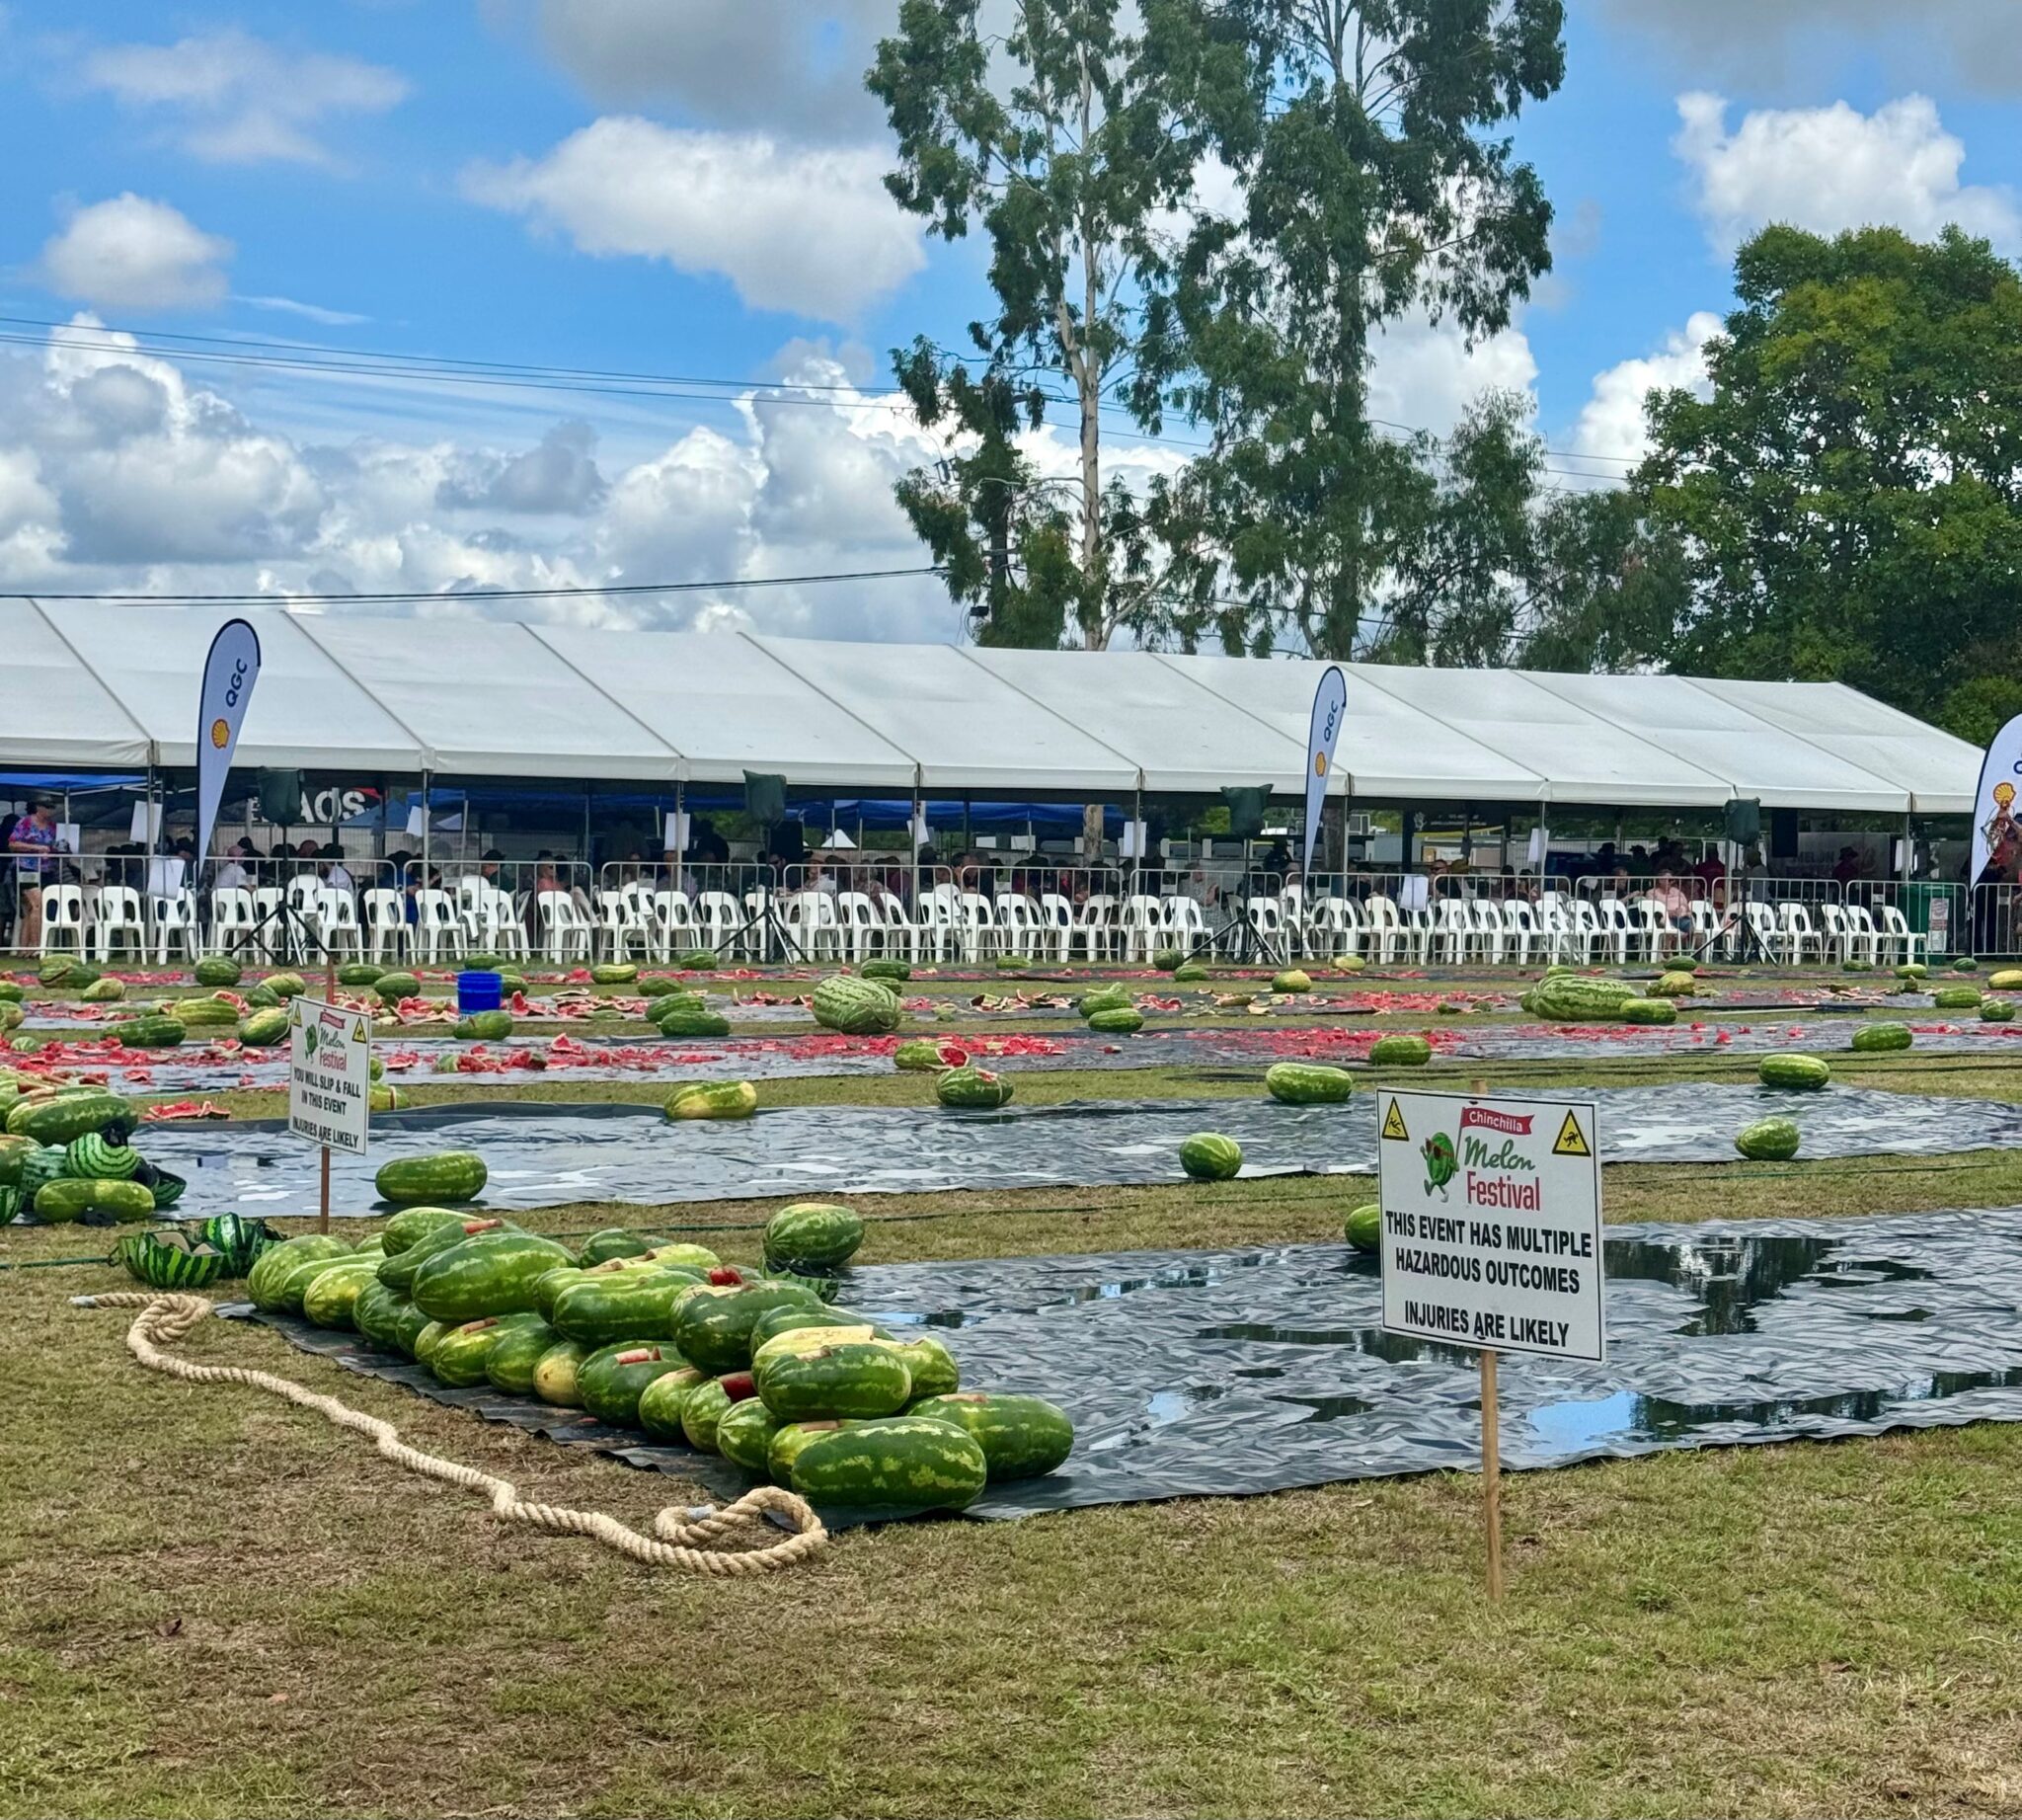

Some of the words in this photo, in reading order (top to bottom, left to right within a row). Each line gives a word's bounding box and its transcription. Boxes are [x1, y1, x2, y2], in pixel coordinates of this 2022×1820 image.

[226, 658, 247, 708] QGC
[1324, 700, 1339, 743] QGC
[319, 1027, 346, 1050] Melon
[320, 1047, 347, 1071] Festival
[294, 1067, 304, 1083] YOU
[305, 1070, 318, 1088] WILL
[320, 1074, 334, 1091] SLIP
[336, 1079, 341, 1094] &
[343, 1081, 361, 1099] FALL
[301, 1089, 308, 1105] IN
[309, 1092, 322, 1109] THIS
[324, 1096, 347, 1116] EVENT
[292, 1116, 318, 1138] INJURIES
[318, 1125, 332, 1142] ARE
[333, 1129, 358, 1149] LIKELY
[1468, 1110, 1523, 1133] Chinchilla
[1464, 1136, 1536, 1171] Melon
[1466, 1171, 1541, 1211] Festival
[1385, 1211, 1415, 1237] THIS
[1420, 1215, 1465, 1243] EVENT
[1470, 1222, 1502, 1248] HAS
[1507, 1226, 1593, 1258] MULTIPLE
[1396, 1247, 1480, 1282] HAZARDOUS
[1485, 1259, 1580, 1294] OUTCOMES
[1405, 1301, 1469, 1333] INJURIES
[1473, 1311, 1506, 1339] ARE
[1510, 1316, 1569, 1347] LIKELY
